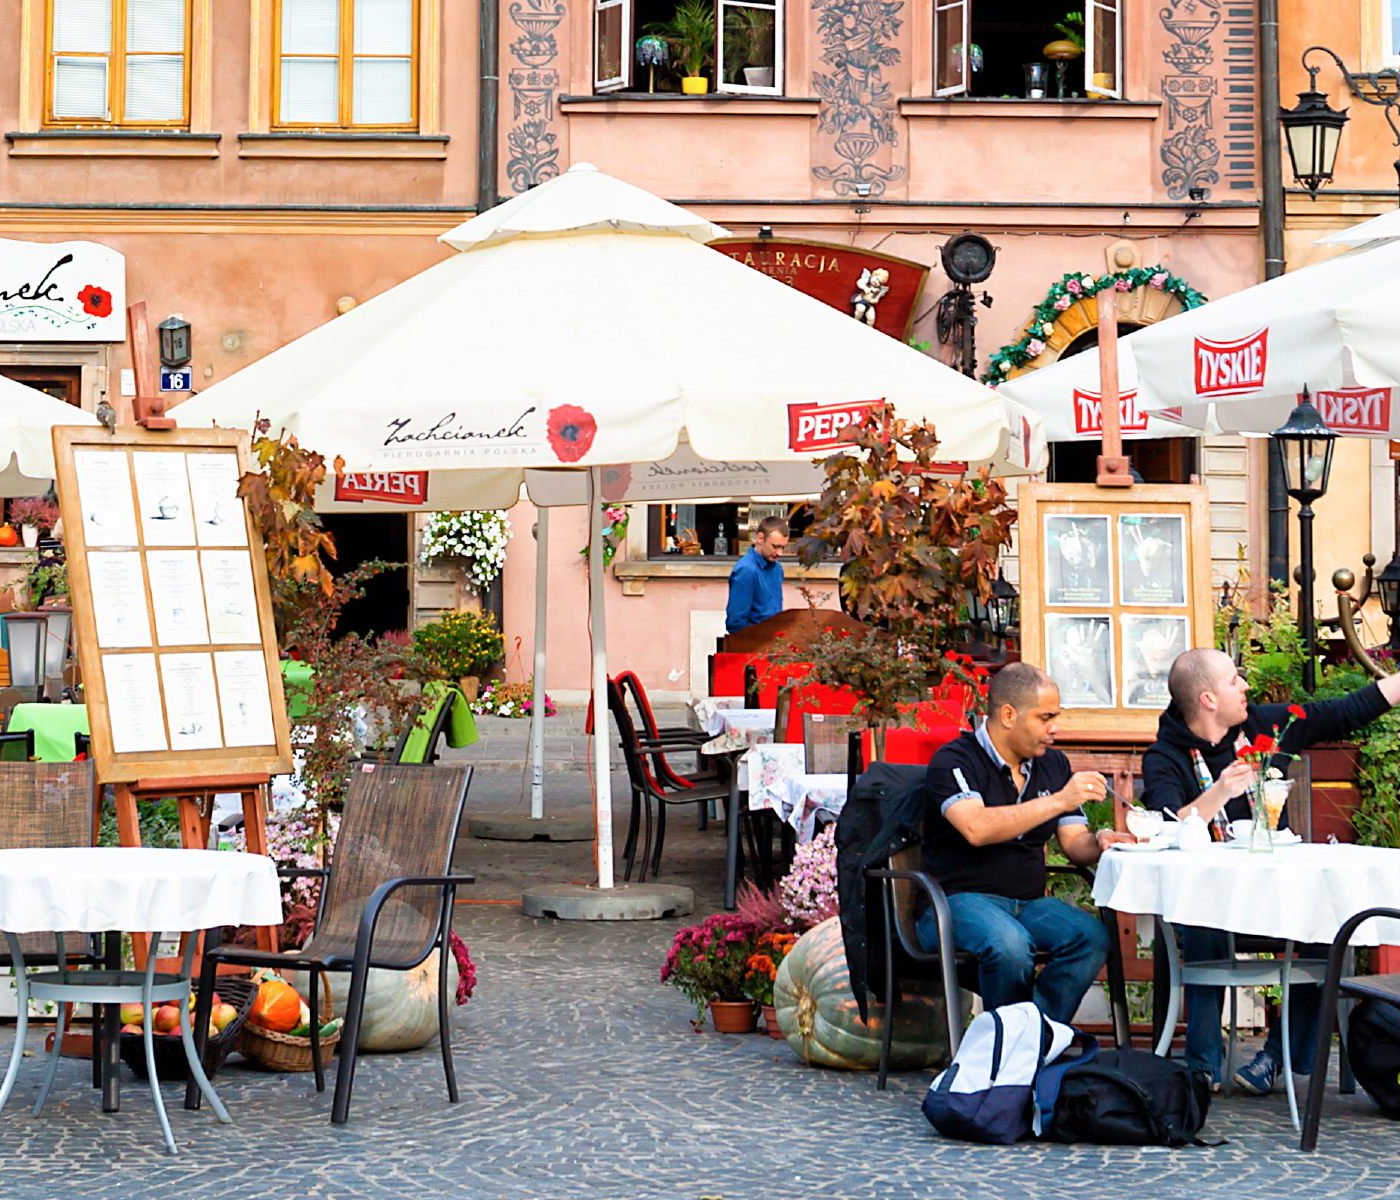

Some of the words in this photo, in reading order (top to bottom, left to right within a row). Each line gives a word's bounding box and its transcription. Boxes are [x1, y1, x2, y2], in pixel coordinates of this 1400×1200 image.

[756, 267, 797, 275] ARNIA
[1198, 339, 1263, 389] TYSKIE
[168, 373, 184, 389] 16
[383, 406, 536, 446] Zachcianek
[383, 449, 476, 459] PIEROGARNIA
[484, 447, 537, 456] POLSKA
